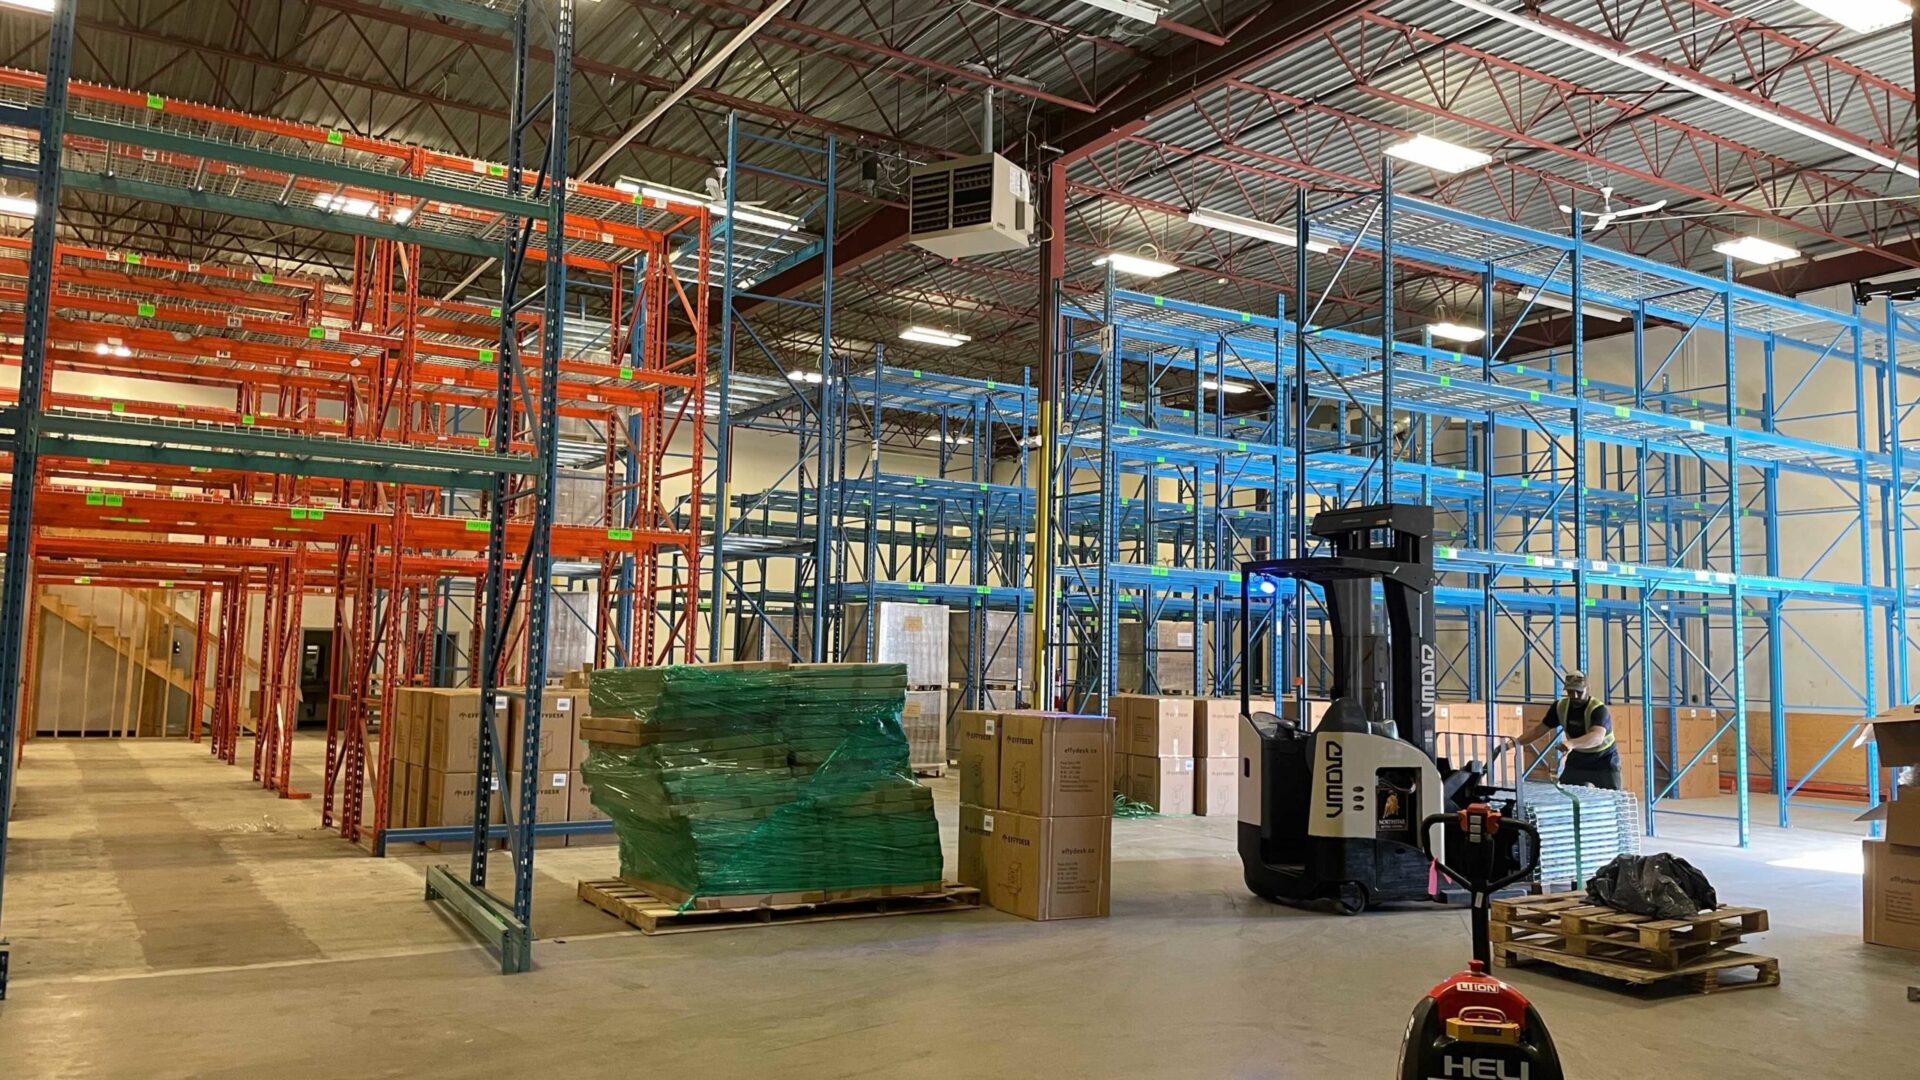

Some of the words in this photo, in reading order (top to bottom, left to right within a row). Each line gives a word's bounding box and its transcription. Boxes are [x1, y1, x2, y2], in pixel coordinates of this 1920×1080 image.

[1421, 644, 1436, 717] CROWN
[1326, 741, 1343, 818] CROWN
[1474, 983, 1496, 992] ION
[1444, 1055, 1529, 1080] HELI
